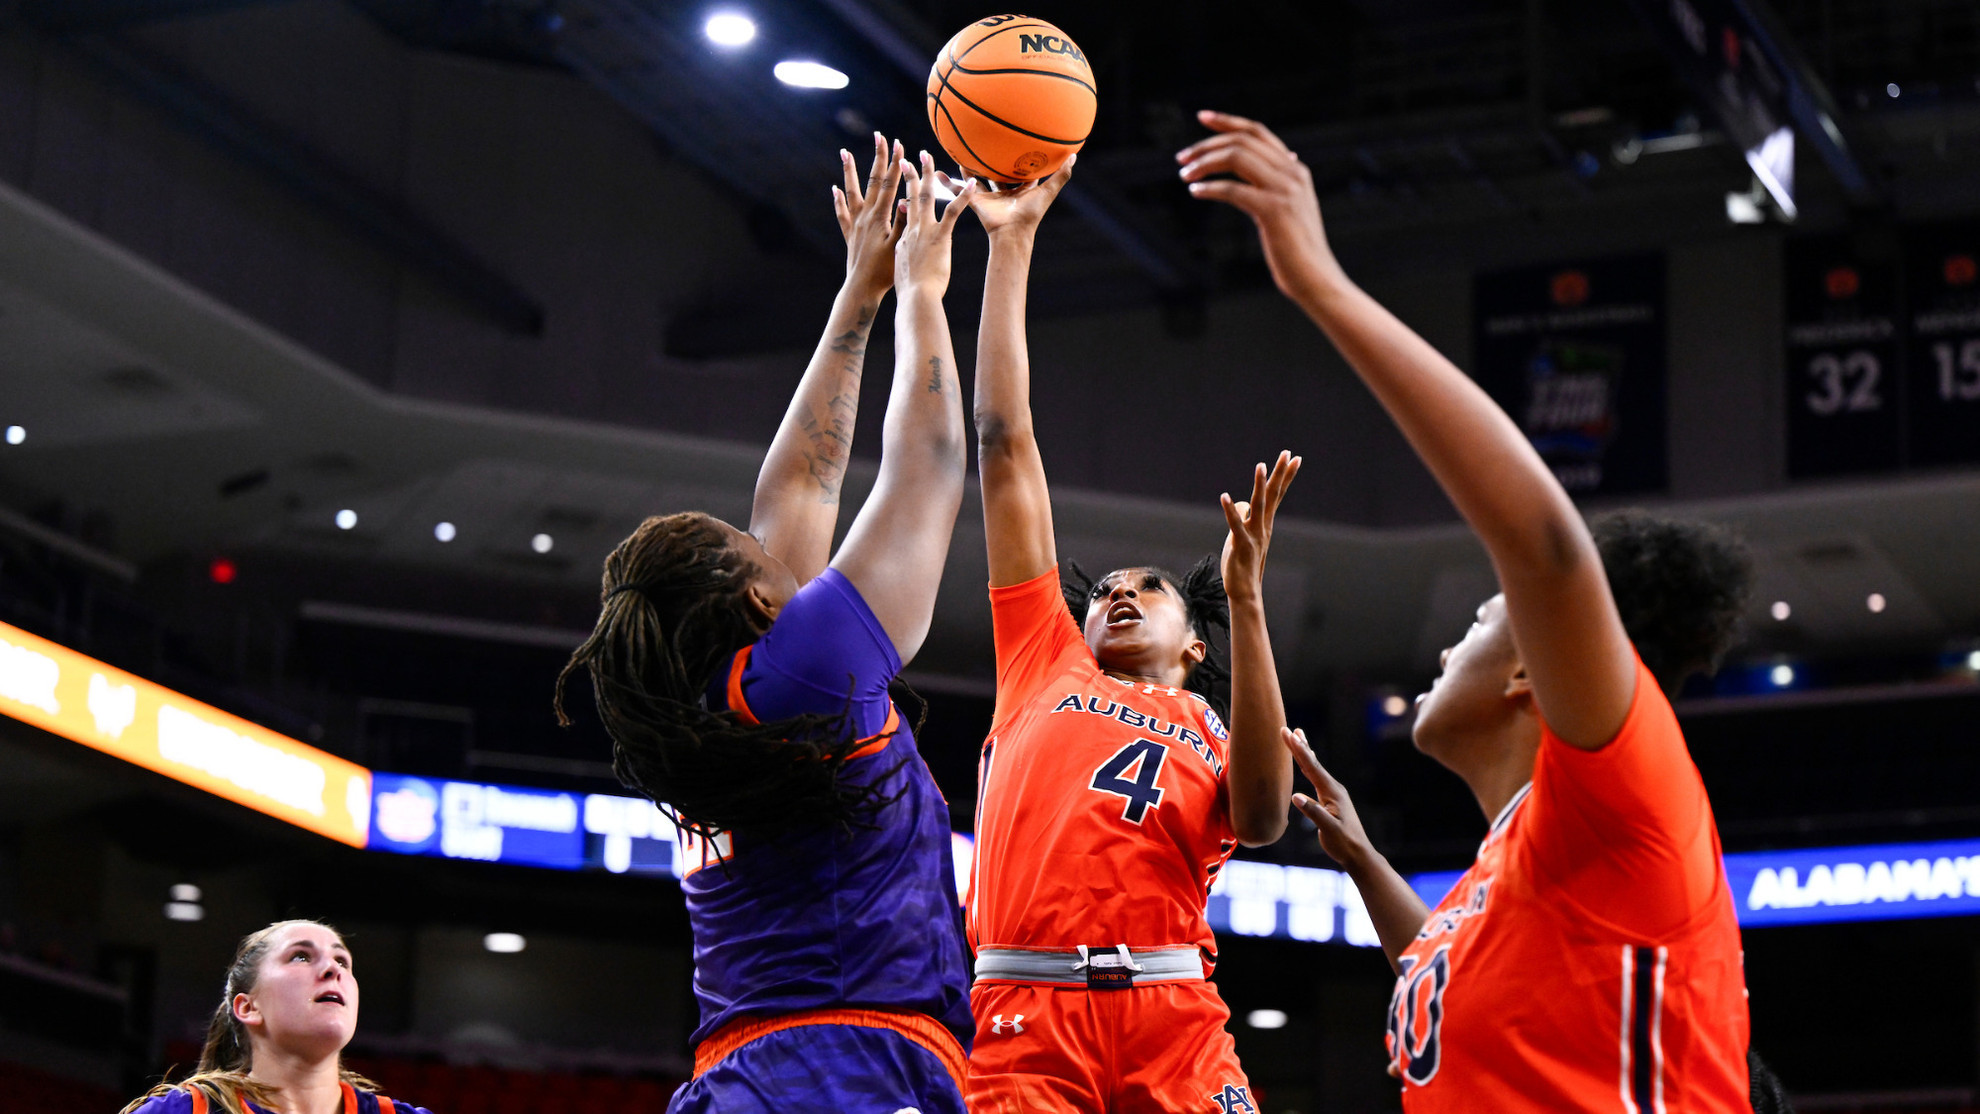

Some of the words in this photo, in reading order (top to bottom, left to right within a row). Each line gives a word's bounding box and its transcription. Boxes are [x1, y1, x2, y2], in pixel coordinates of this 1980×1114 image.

[1019, 34, 1087, 68] NCAA
[1806, 351, 1882, 415] 32
[1932, 340, 1980, 401] 15
[1051, 693, 1223, 778] AUBURN
[1205, 709, 1228, 740] SEC
[1088, 737, 1169, 826] 4
[1091, 973, 1128, 981] AUBURN
